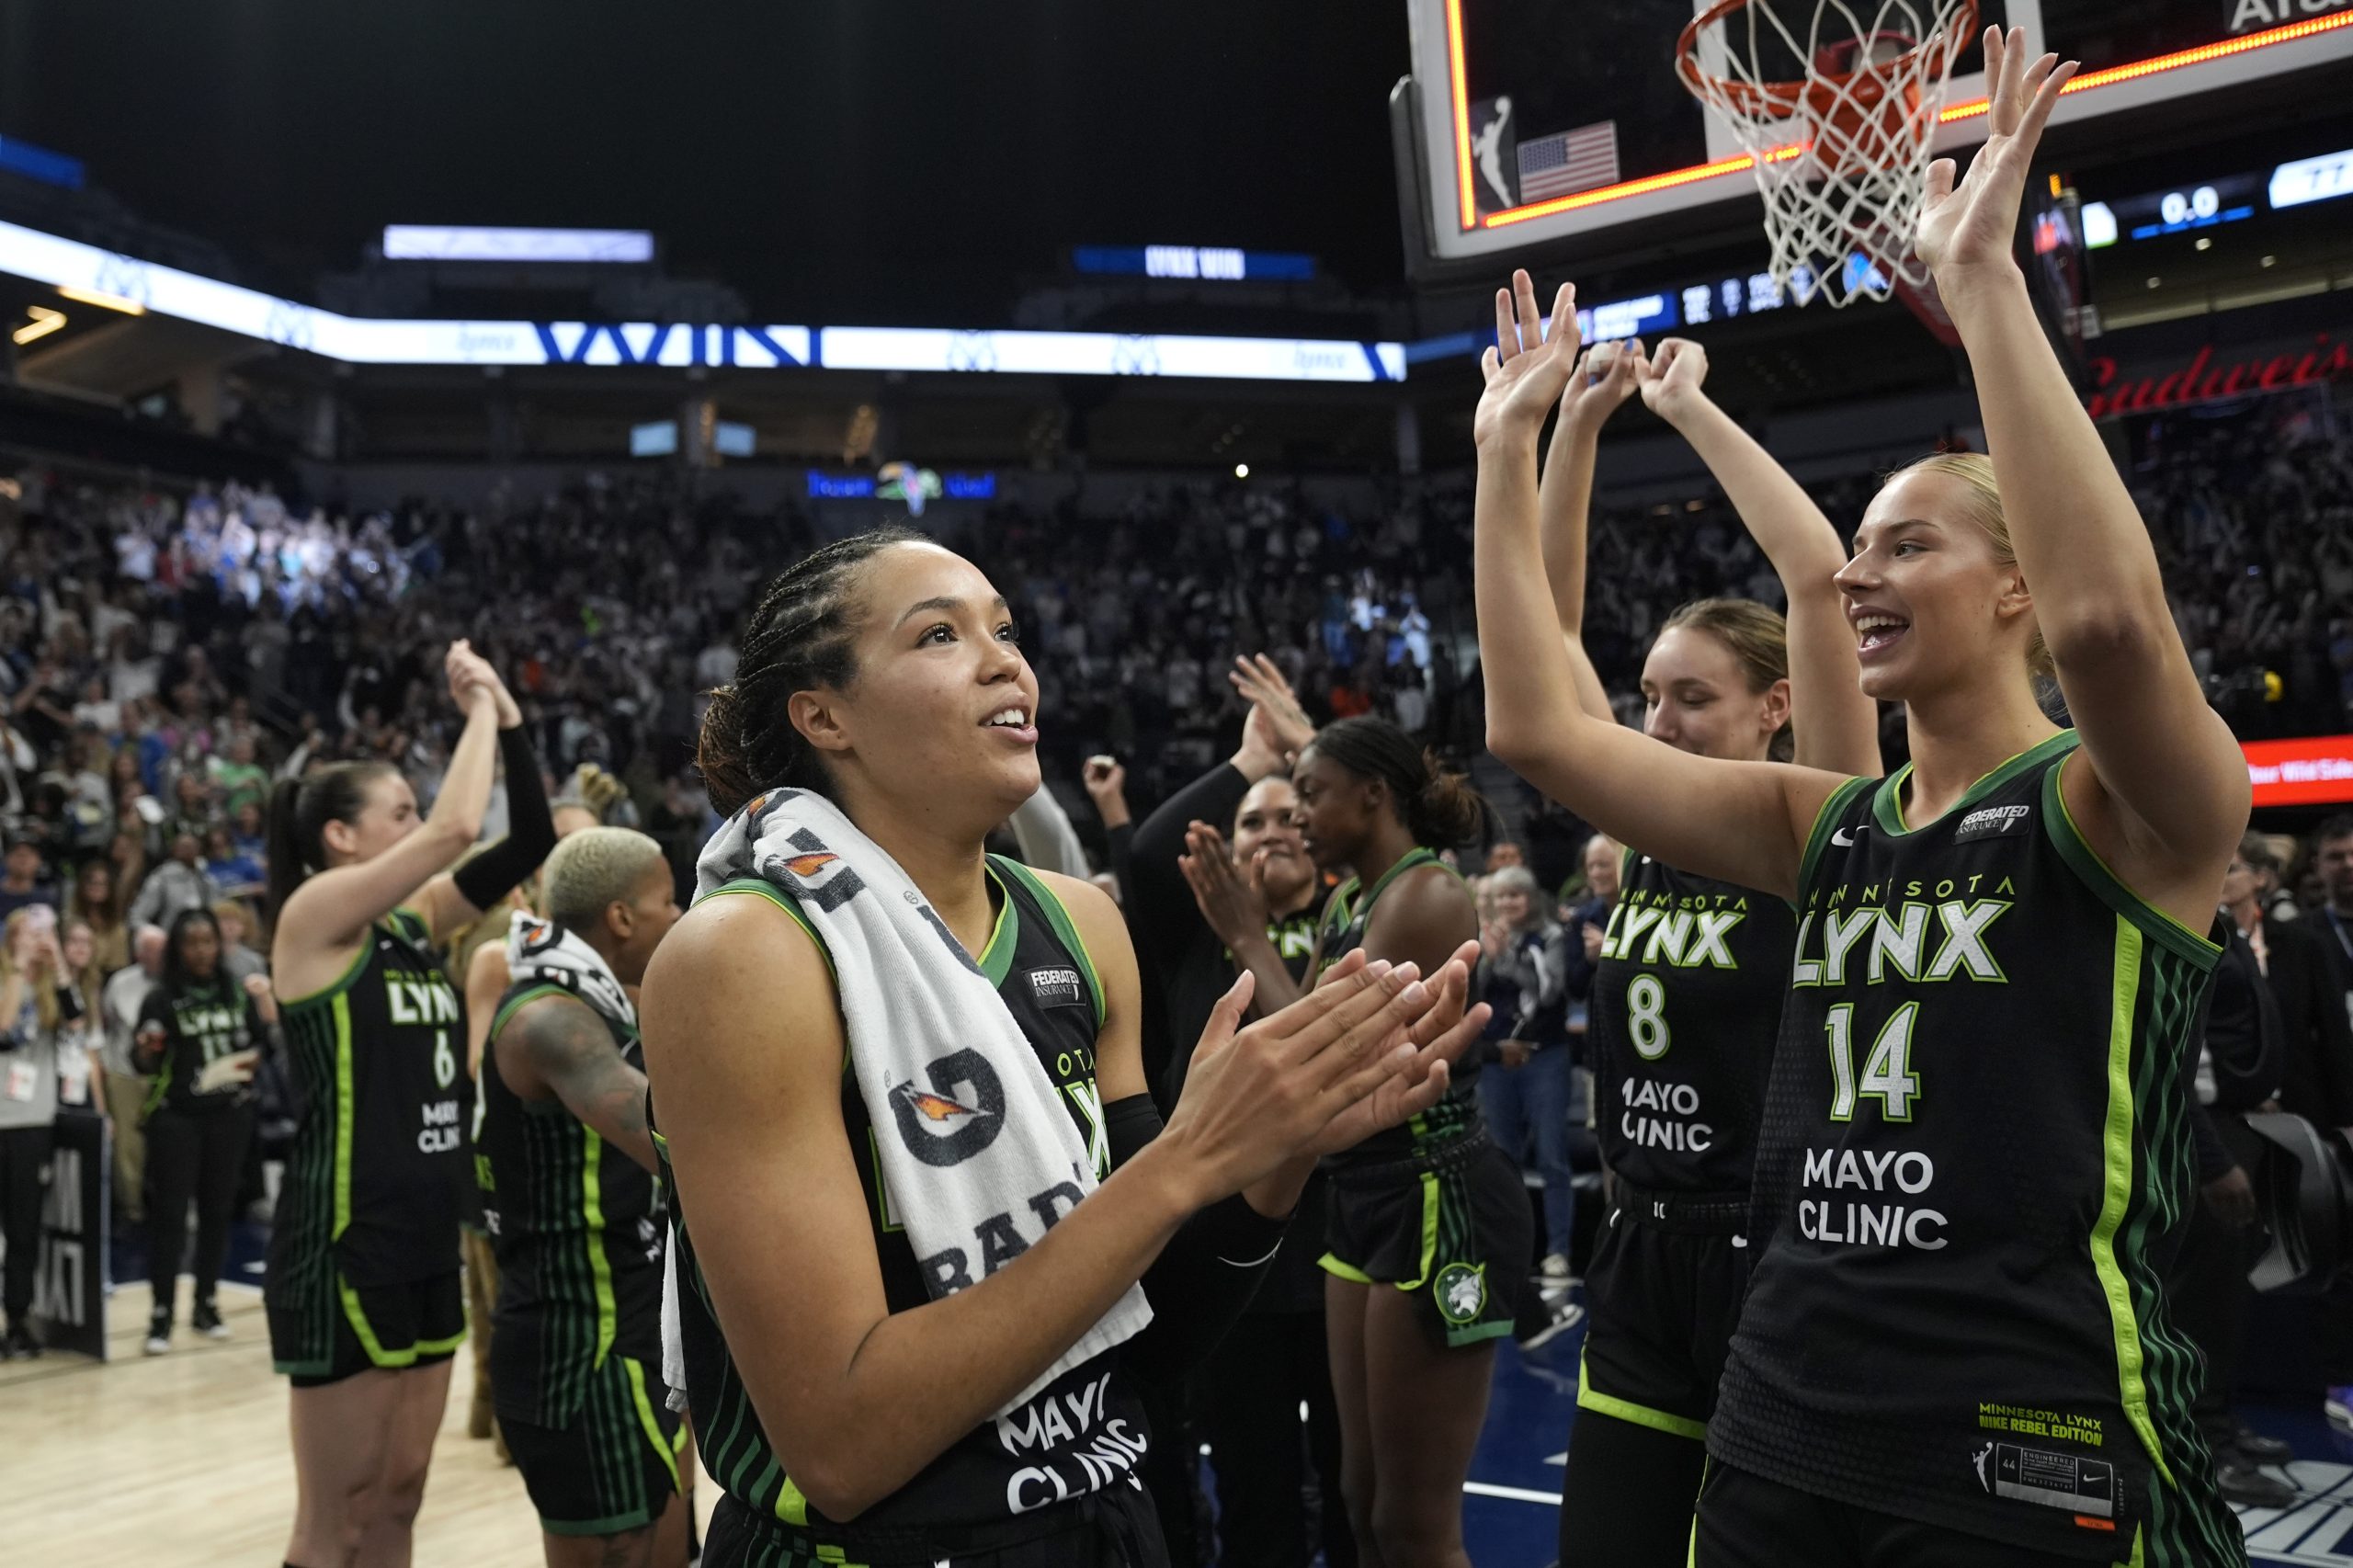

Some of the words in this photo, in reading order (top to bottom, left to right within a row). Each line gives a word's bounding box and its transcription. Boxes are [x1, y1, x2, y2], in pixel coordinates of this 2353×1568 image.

[2161, 186, 2220, 225] 0.0
[1960, 805, 2029, 827] FEDERATED
[1600, 903, 1746, 970] LYNX
[1793, 898, 2015, 990] LYNX
[1030, 970, 1080, 987] FEDERATED
[1035, 984, 1074, 997] INSURANCE
[1627, 973, 1671, 1060] 8
[434, 1028, 456, 1089] 6
[1824, 1000, 1922, 1123] 14
[1802, 1148, 1934, 1194] MAYO
[1799, 1199, 1949, 1250] CLINIC
[1979, 1403, 2060, 1423] MINNESOTA
[2066, 1414, 2102, 1432] LYNX
[1979, 1415, 2008, 1430] NIKE
[2010, 1417, 2049, 1436] REBEL
[2051, 1424, 2103, 1447] EDITION
[1007, 1418, 1148, 1515] CLINIC
[2002, 1459, 2016, 1469] 44
[2023, 1452, 2075, 1466] ENGINEERED
